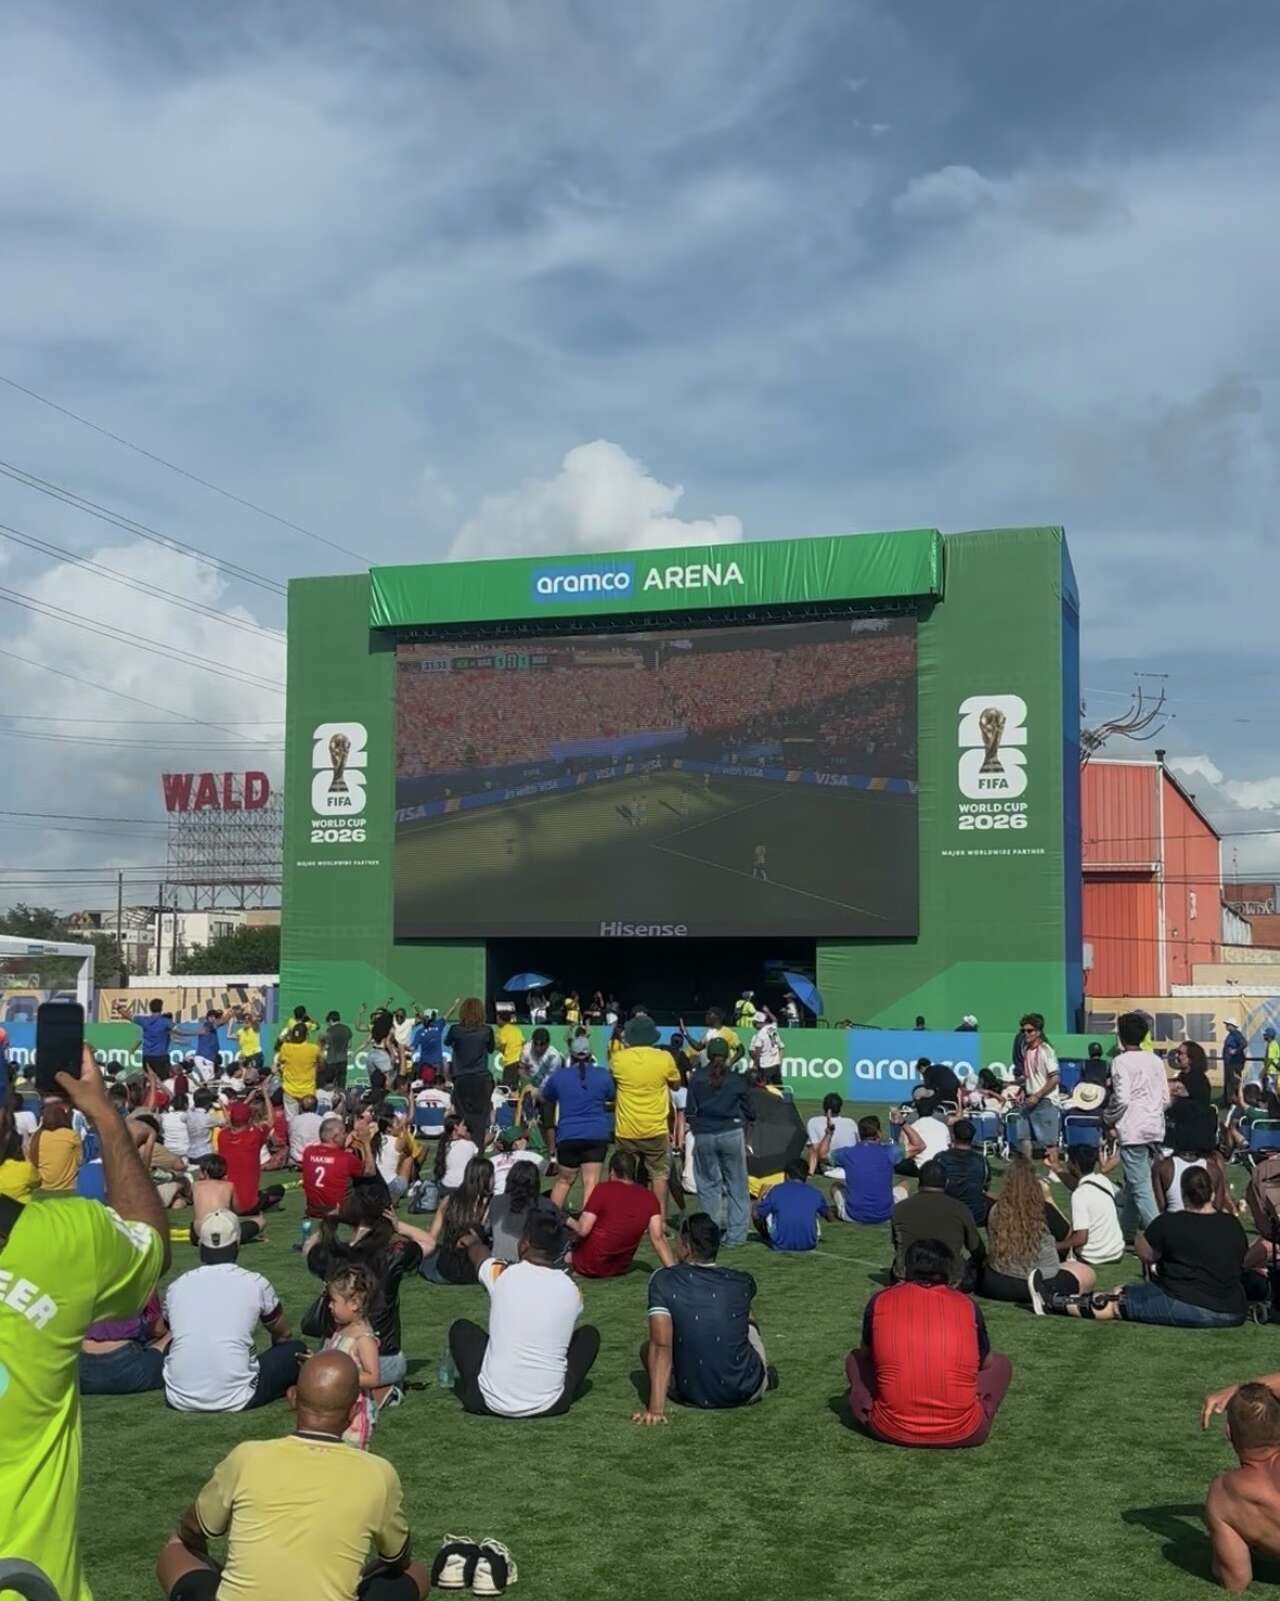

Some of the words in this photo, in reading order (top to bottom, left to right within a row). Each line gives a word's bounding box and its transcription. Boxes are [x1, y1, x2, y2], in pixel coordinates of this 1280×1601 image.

[537, 571, 630, 594] aramco
[643, 562, 744, 591] ARENA
[815, 771, 849, 787] VISA
[978, 778, 1008, 789] FIFA
[162, 771, 270, 811] WALD
[327, 797, 352, 807] FIFA
[959, 803, 1002, 813] WORLD
[1004, 802, 1028, 812] CUP
[311, 819, 346, 828] WORLD
[347, 818, 366, 827] CUP
[958, 814, 1028, 830] 2026
[310, 829, 366, 843] 2026
[600, 921, 688, 937] Hisense
[855, 1057, 975, 1080] arao
[315, 1166, 326, 1188] 2
